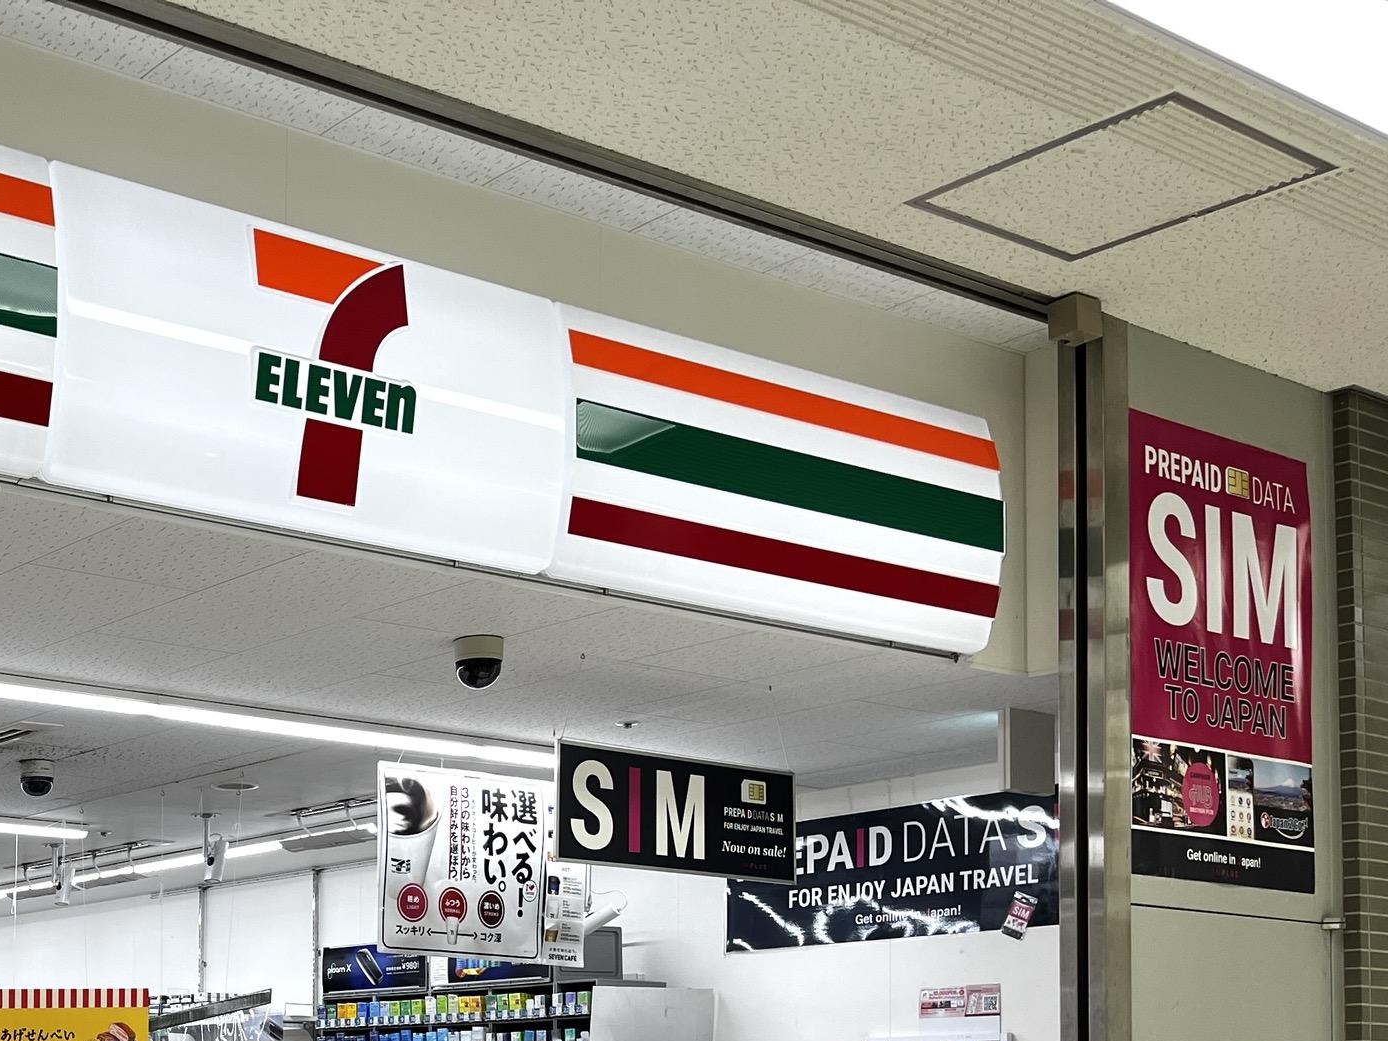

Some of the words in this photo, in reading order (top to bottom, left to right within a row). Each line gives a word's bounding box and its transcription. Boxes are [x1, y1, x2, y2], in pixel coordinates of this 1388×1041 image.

[1144, 445, 1221, 493] PREPAID
[1252, 476, 1295, 514] DATA
[1146, 491, 1298, 649] SIM
[1153, 637, 1295, 703] WELCOME
[1164, 684, 1199, 724] TO
[1206, 692, 1287, 740] JAPAN
[570, 760, 705, 861] SIM
[724, 822, 733, 830] FOR
[734, 823, 749, 832] ENJOY
[750, 824, 765, 833] JAPAN
[766, 826, 784, 836] TRAVEL
[722, 841, 745, 854] Now
[748, 845, 761, 855] on
[763, 846, 787, 858] sale!
[1187, 848, 1202, 861] Get
[1203, 851, 1227, 865] online
[1229, 854, 1236, 865] in
[1239, 857, 1261, 869] apan!
[788, 888, 822, 909] FOR
[828, 880, 886, 904] ENJOY
[891, 873, 954, 898] JAPAN
[960, 864, 1039, 890] TRAVEL
[395, 924, 426, 936] スッキリ
[855, 912, 873, 925] Get
